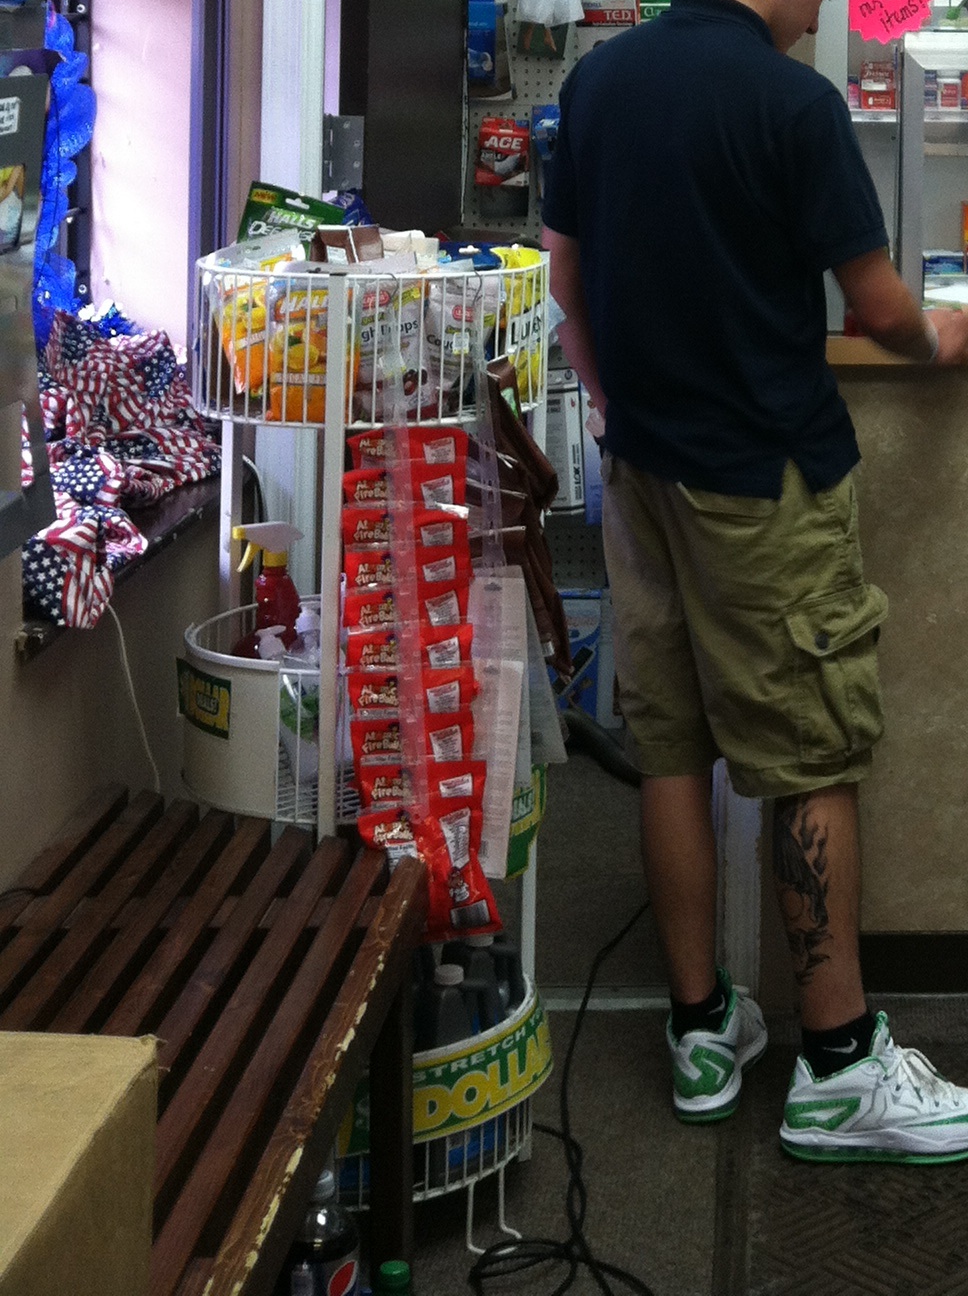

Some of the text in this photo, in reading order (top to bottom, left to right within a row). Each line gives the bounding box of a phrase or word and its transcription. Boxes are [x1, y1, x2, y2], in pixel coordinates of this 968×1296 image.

[484, 135, 524, 150] ACE
[267, 210, 317, 230] HALLS
[280, 294, 329, 314] HALL
[413, 1027, 526, 1083] STRETCH
